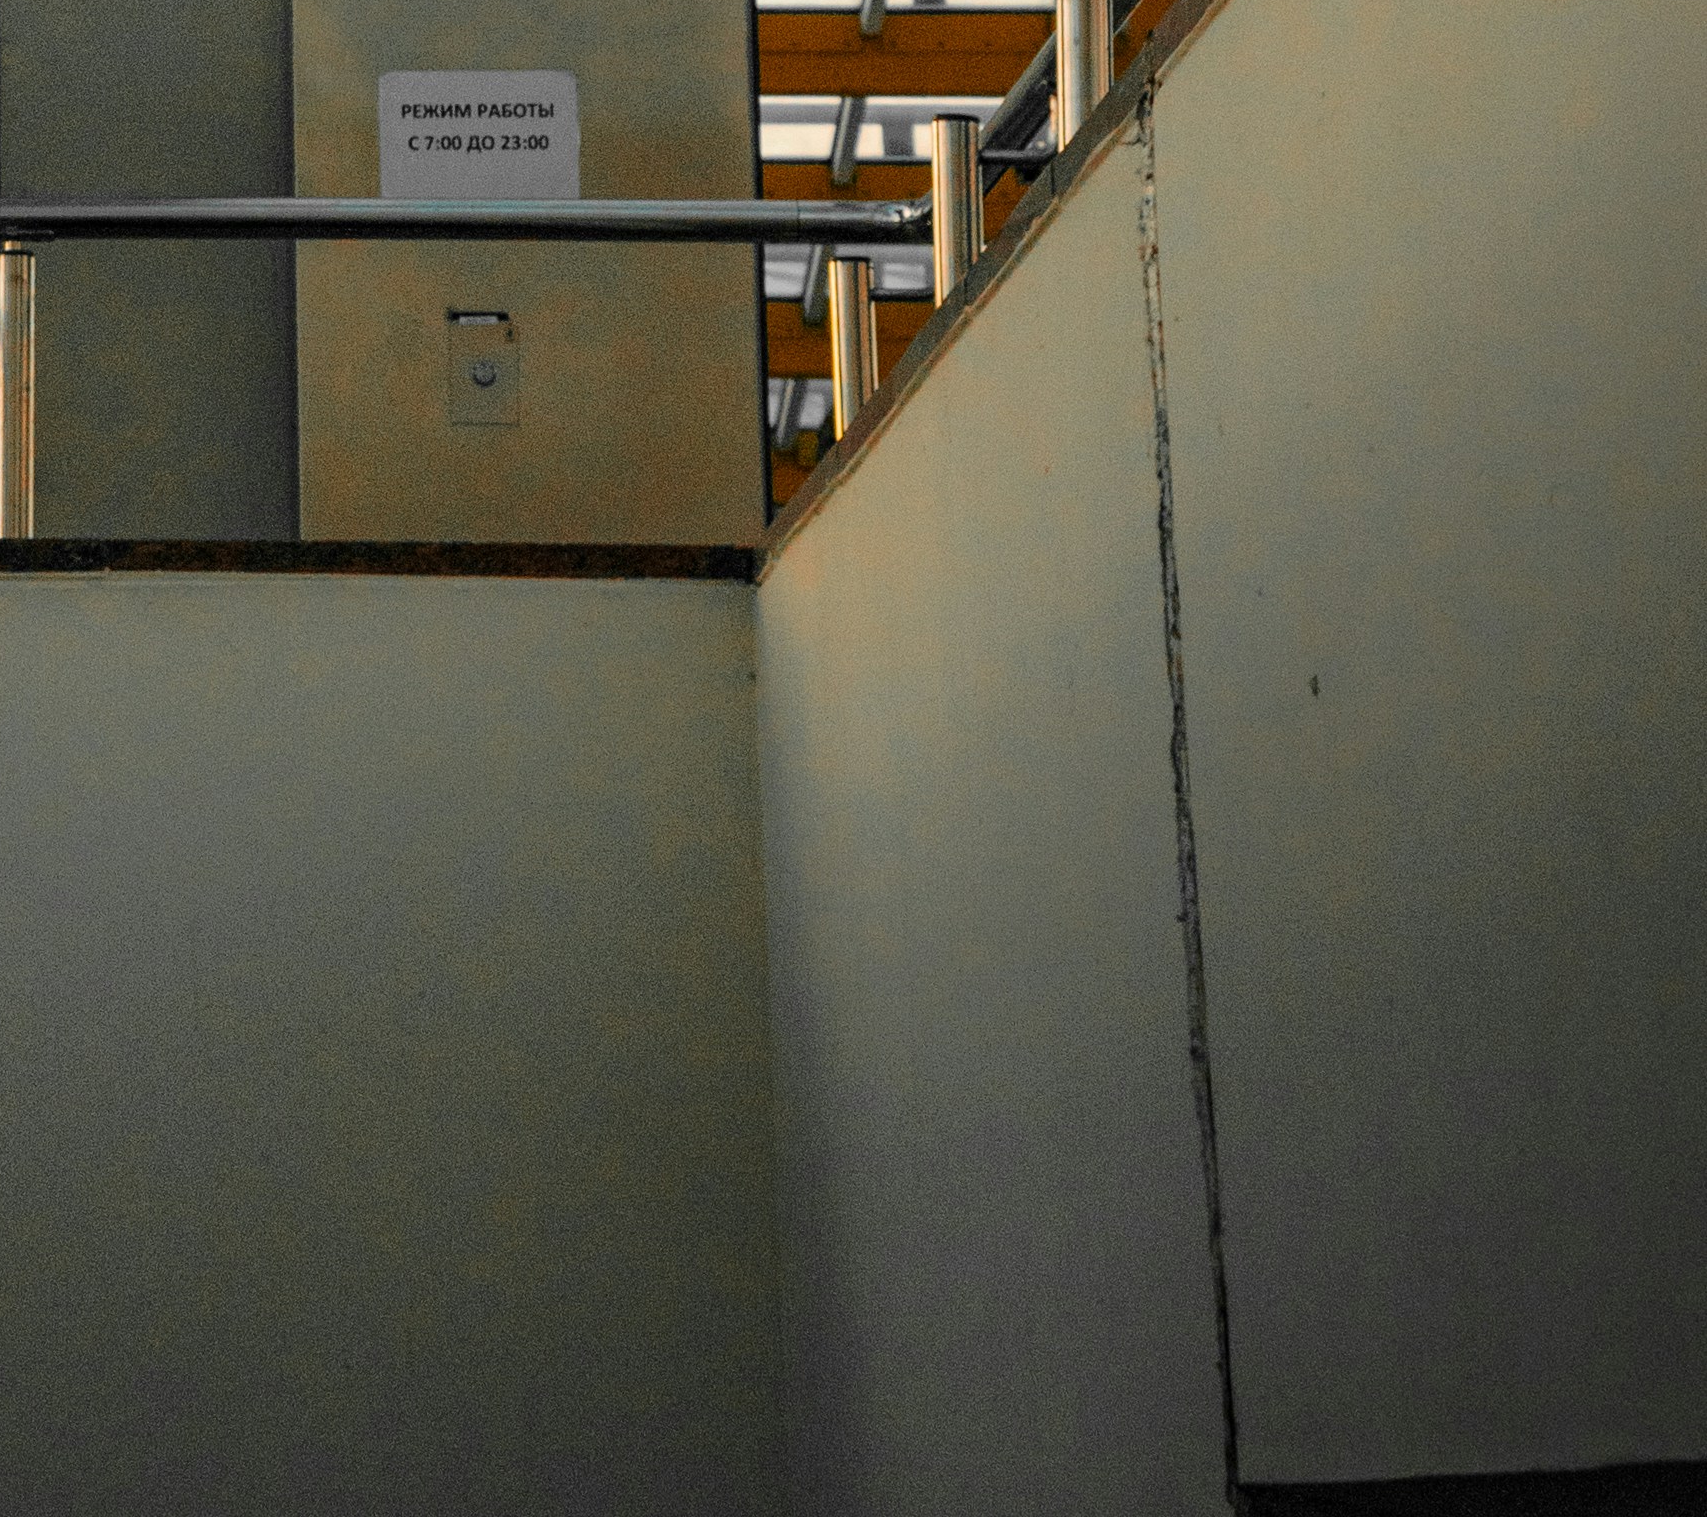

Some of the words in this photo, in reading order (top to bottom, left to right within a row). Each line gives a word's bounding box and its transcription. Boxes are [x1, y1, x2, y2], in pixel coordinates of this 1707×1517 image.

[400, 103, 473, 118] РЕЖИМ
[477, 102, 555, 118] РАБОТЫ
[408, 135, 420, 151] С
[424, 135, 462, 150] 7:00
[467, 134, 495, 153] ДО
[500, 134, 550, 150] 23:00
